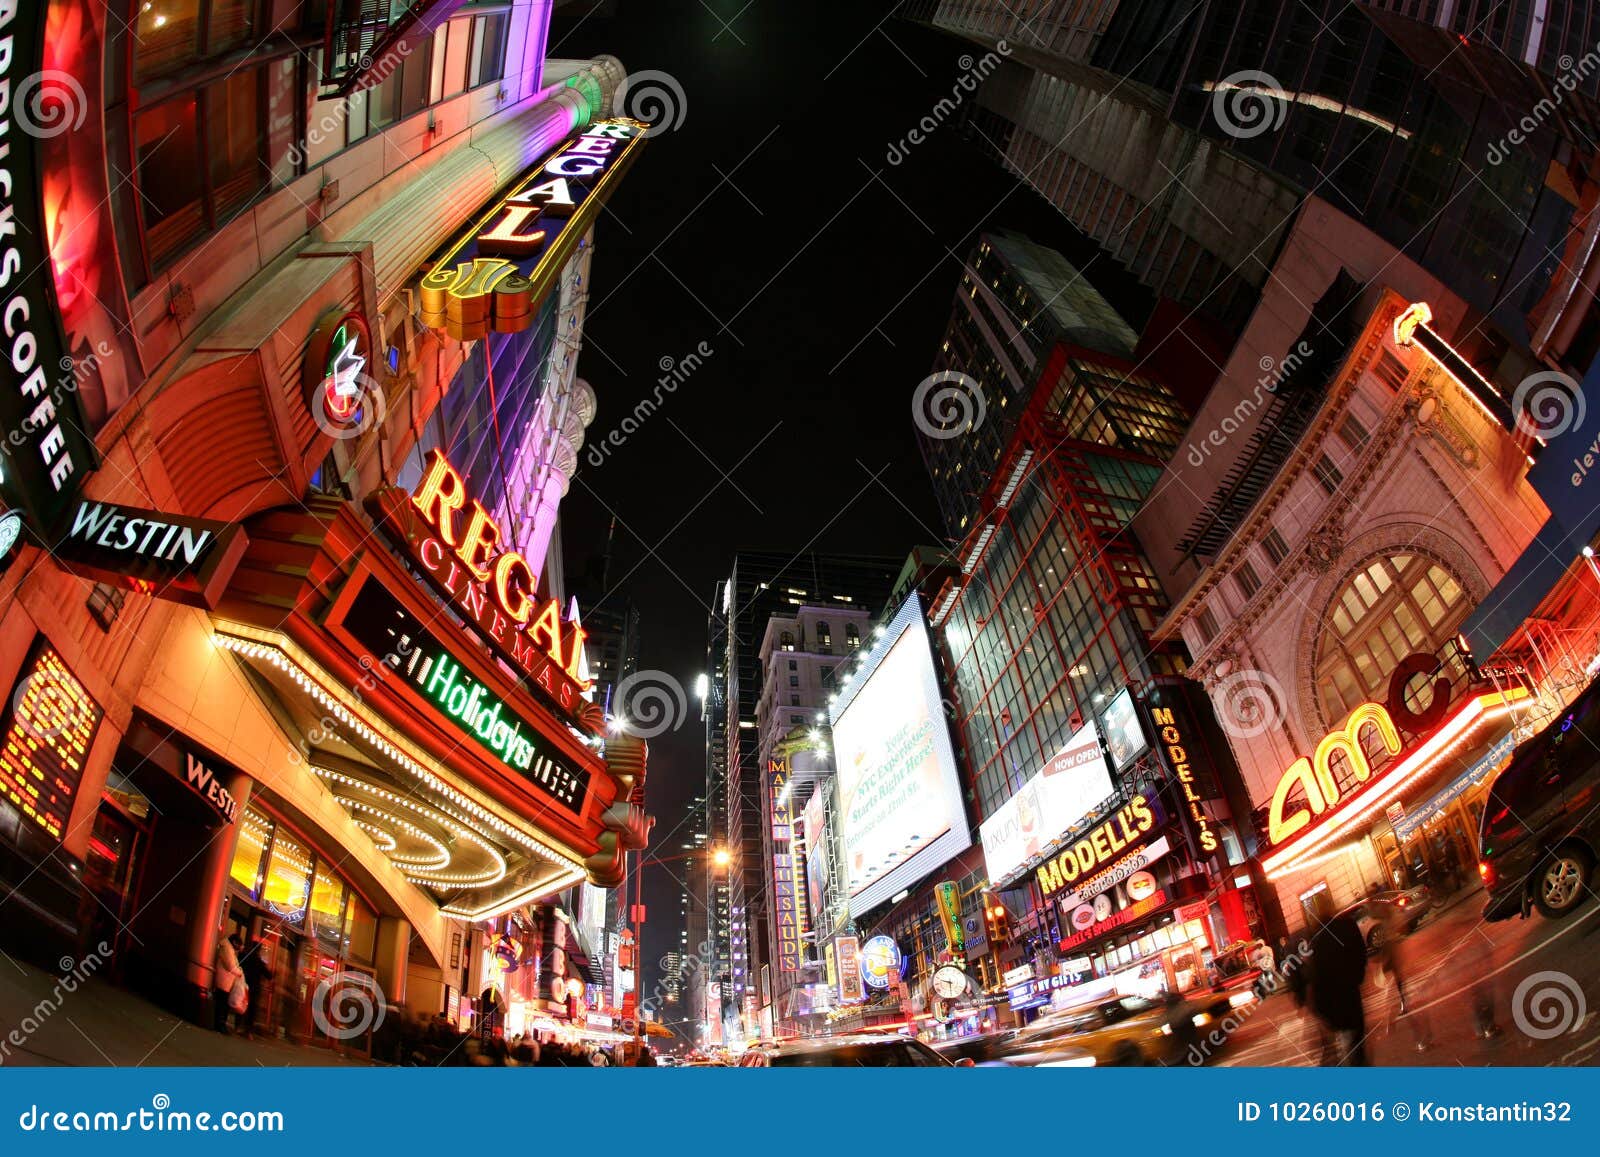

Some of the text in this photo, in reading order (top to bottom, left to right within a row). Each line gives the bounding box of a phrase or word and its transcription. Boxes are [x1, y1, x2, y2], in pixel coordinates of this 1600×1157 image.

[478, 122, 632, 252] REGAL
[4, 296, 75, 492] COFFEE
[1571, 432, 1600, 487] elev
[70, 501, 212, 565] WESTIN
[412, 447, 592, 691] REGAL
[420, 538, 578, 708] CINEMAS
[427, 654, 536, 768] Holidays
[1054, 747, 1099, 773] NOW OPEN
[187, 752, 236, 824] WESTI
[1151, 706, 1217, 851] MODELL'S
[1036, 795, 1154, 895] MODELL'S
[1051, 972, 1082, 989] GIFTS
